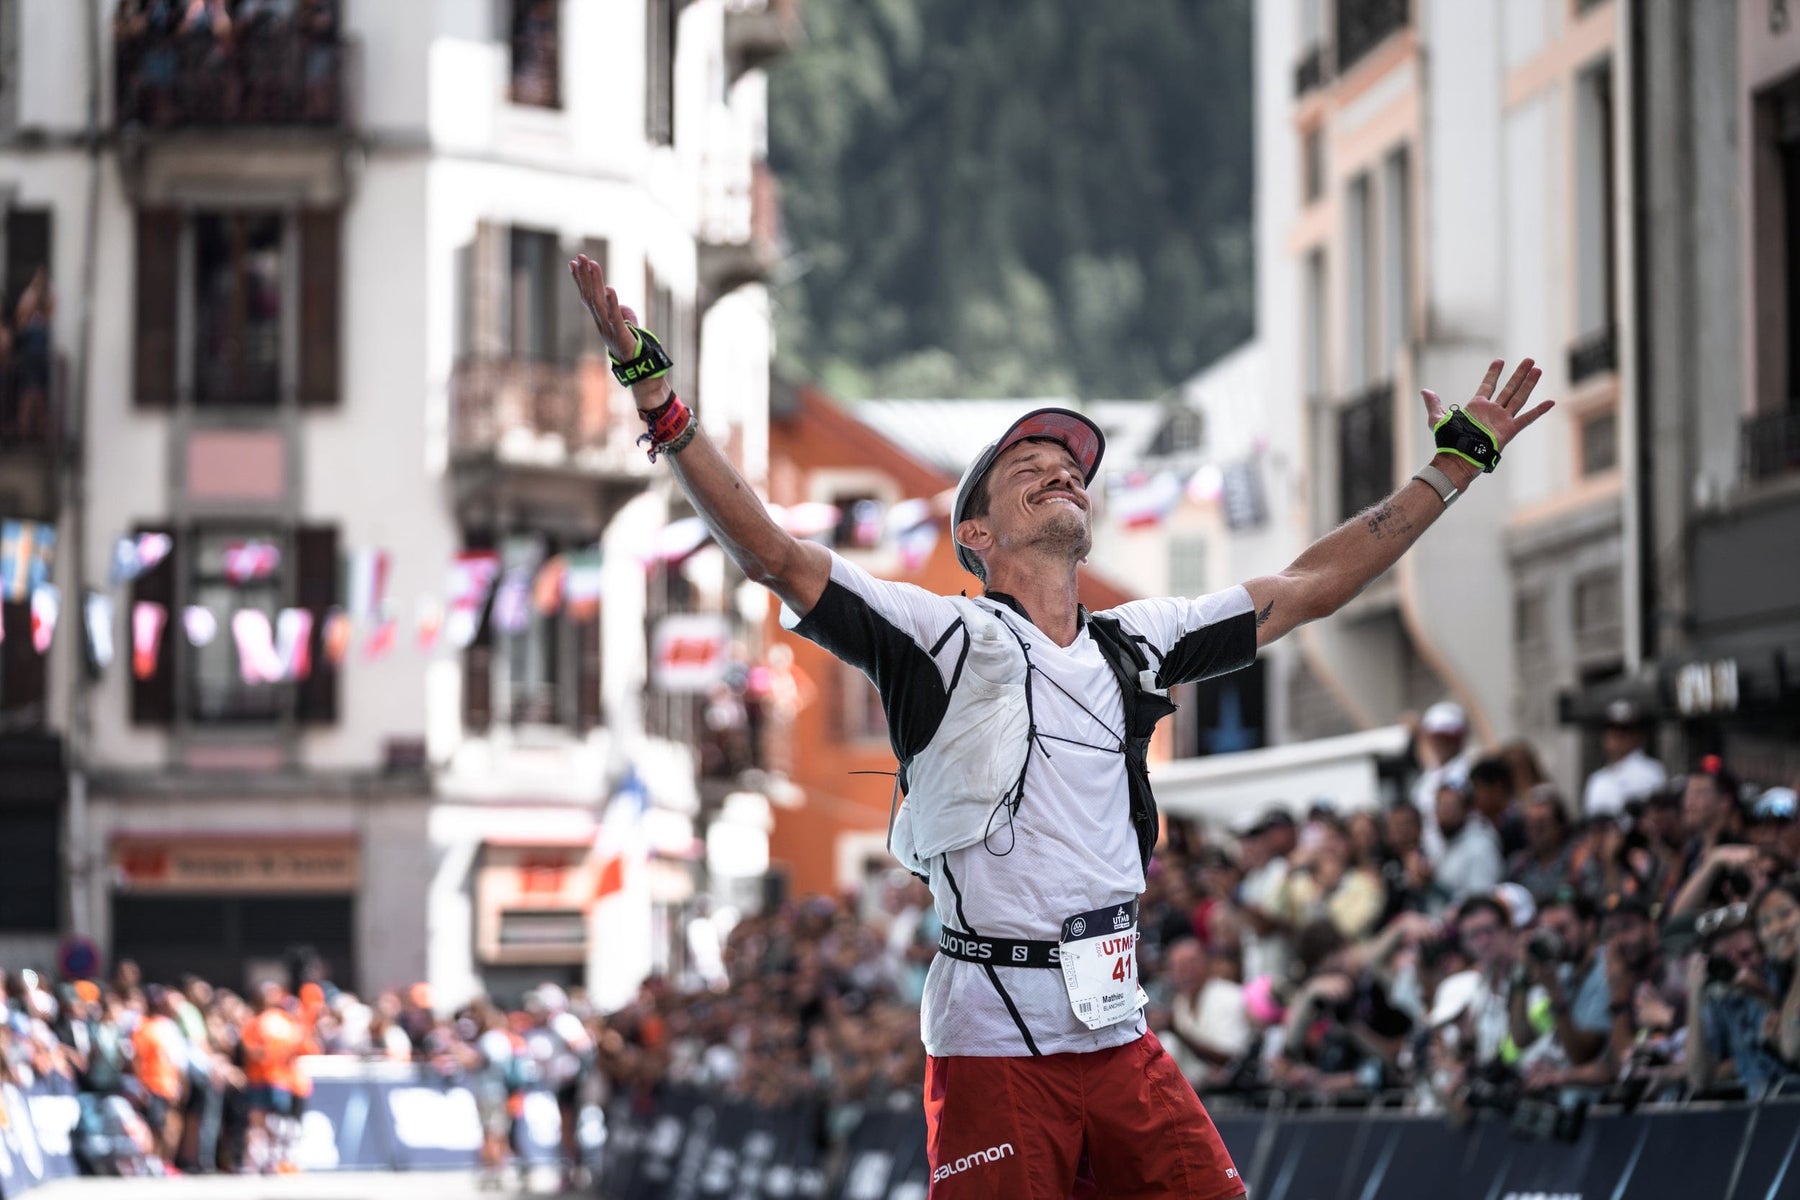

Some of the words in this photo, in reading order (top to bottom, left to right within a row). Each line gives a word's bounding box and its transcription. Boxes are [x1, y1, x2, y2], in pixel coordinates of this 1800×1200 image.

[616, 359, 655, 382] LEKI
[1112, 915, 1130, 925] UTMB
[1102, 934, 1134, 956] UTMB
[1112, 953, 1132, 983] 41
[933, 1143, 1015, 1184] salomon
